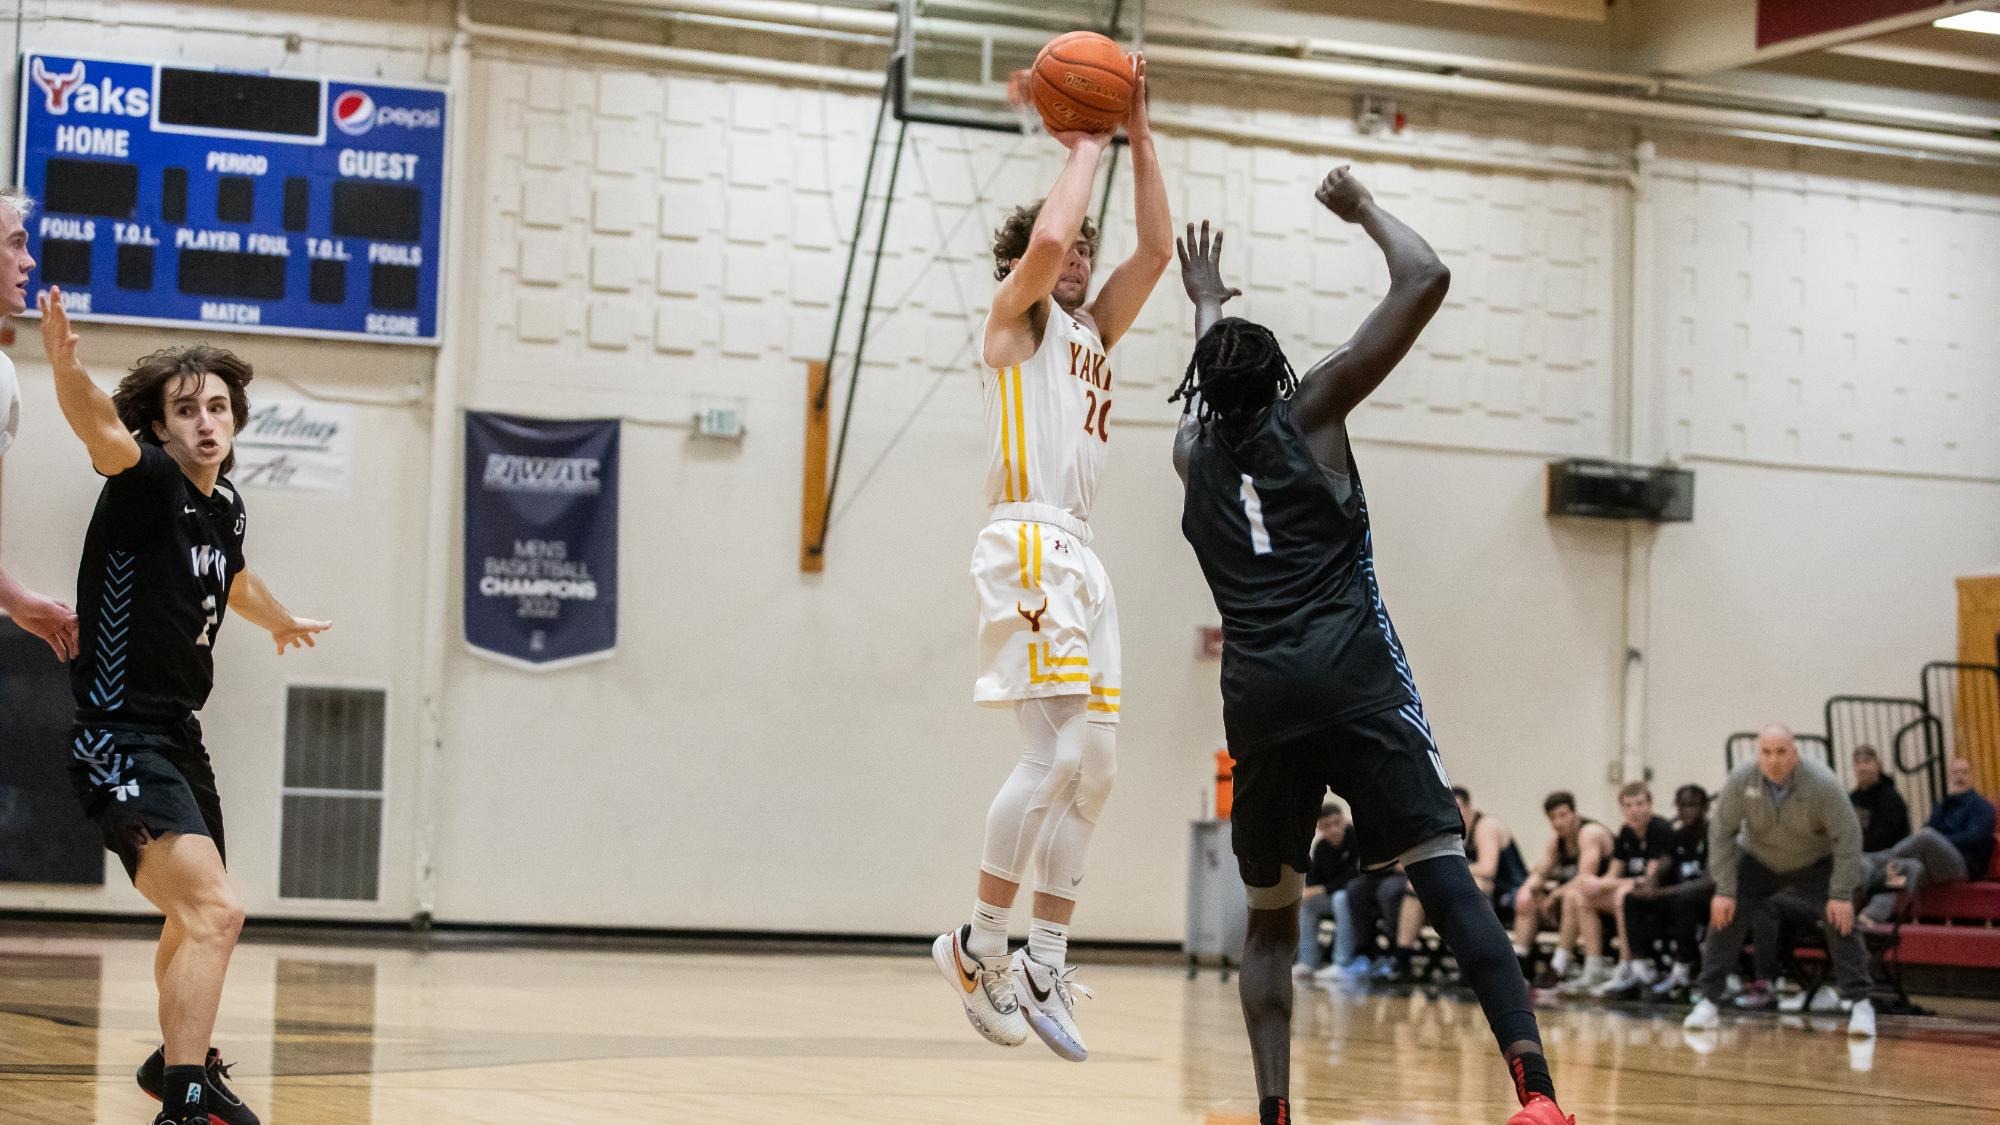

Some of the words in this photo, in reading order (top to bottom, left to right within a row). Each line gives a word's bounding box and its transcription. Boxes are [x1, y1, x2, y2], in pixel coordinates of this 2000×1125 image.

[376, 105, 441, 129] pepsi
[56, 124, 130, 158] HOME
[206, 151, 268, 176] PERIOD
[338, 148, 419, 180] GUEST
[39, 216, 96, 242] FOULS
[112, 222, 160, 246] T.O.L.
[175, 227, 240, 252] PLAYER
[247, 232, 291, 256] FOUL
[306, 237, 352, 261] T.O.L.
[368, 243, 423, 266] FOULS
[37, 288, 92, 313] SORE
[201, 301, 261, 325] MATCH
[365, 313, 419, 337] SCORE
[1239, 473, 1273, 556] 1
[479, 575, 598, 601] CHAMPIONS
